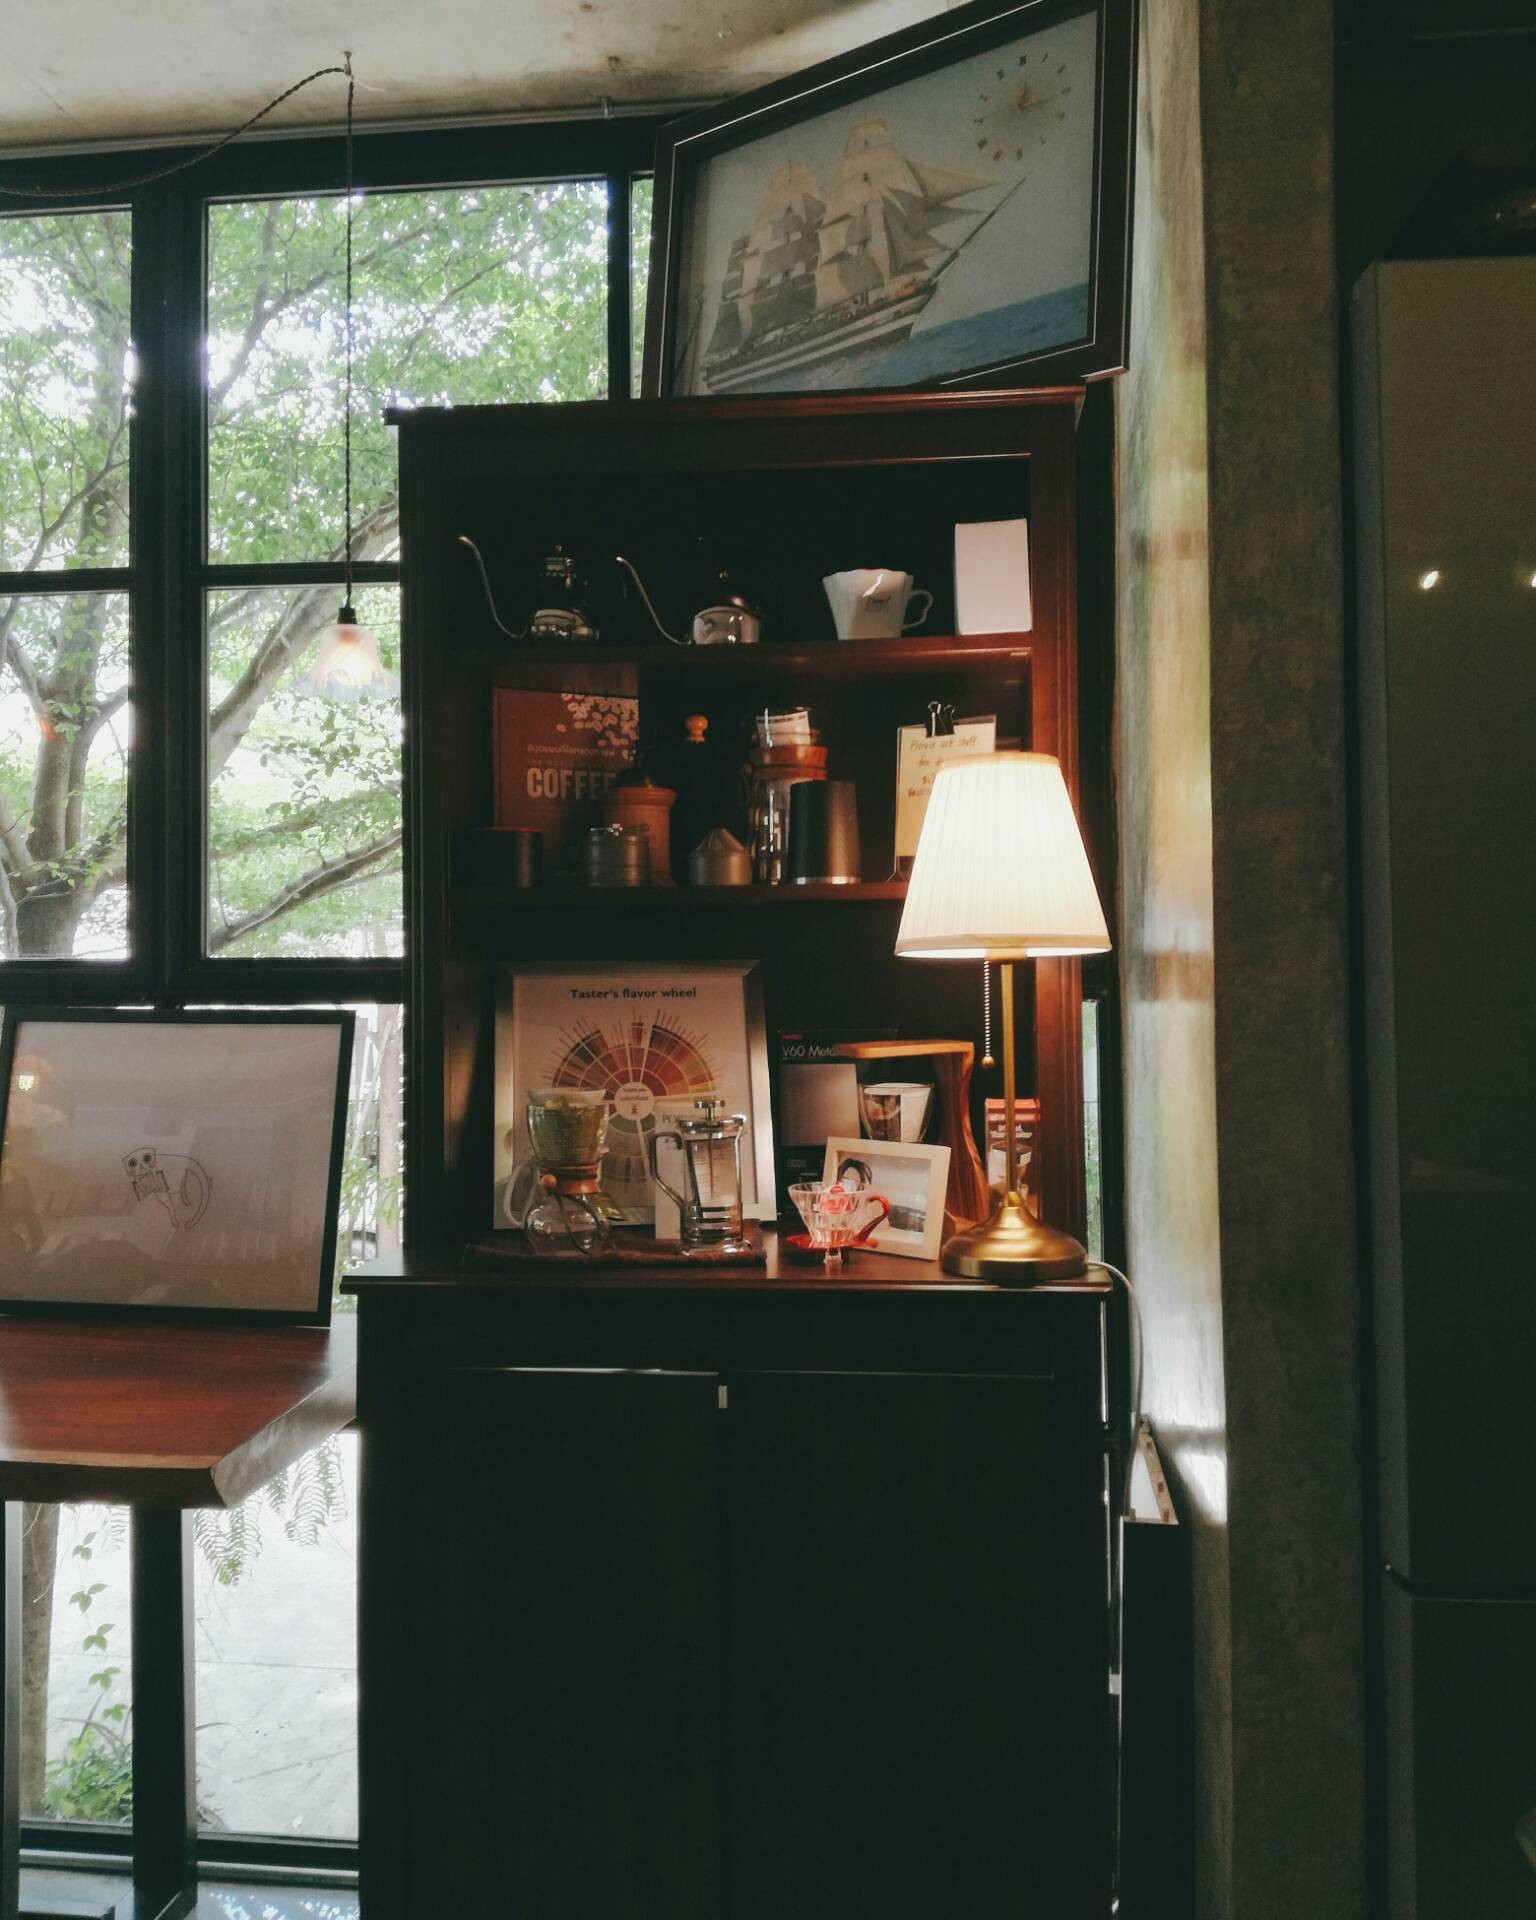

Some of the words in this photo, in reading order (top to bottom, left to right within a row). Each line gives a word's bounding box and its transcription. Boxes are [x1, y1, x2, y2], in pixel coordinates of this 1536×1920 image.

[527, 767, 617, 800] COFFEE
[570, 988, 619, 999] Taster's
[623, 987, 658, 999] flavor
[661, 987, 697, 999] wheel
[782, 1044, 806, 1057] V60
